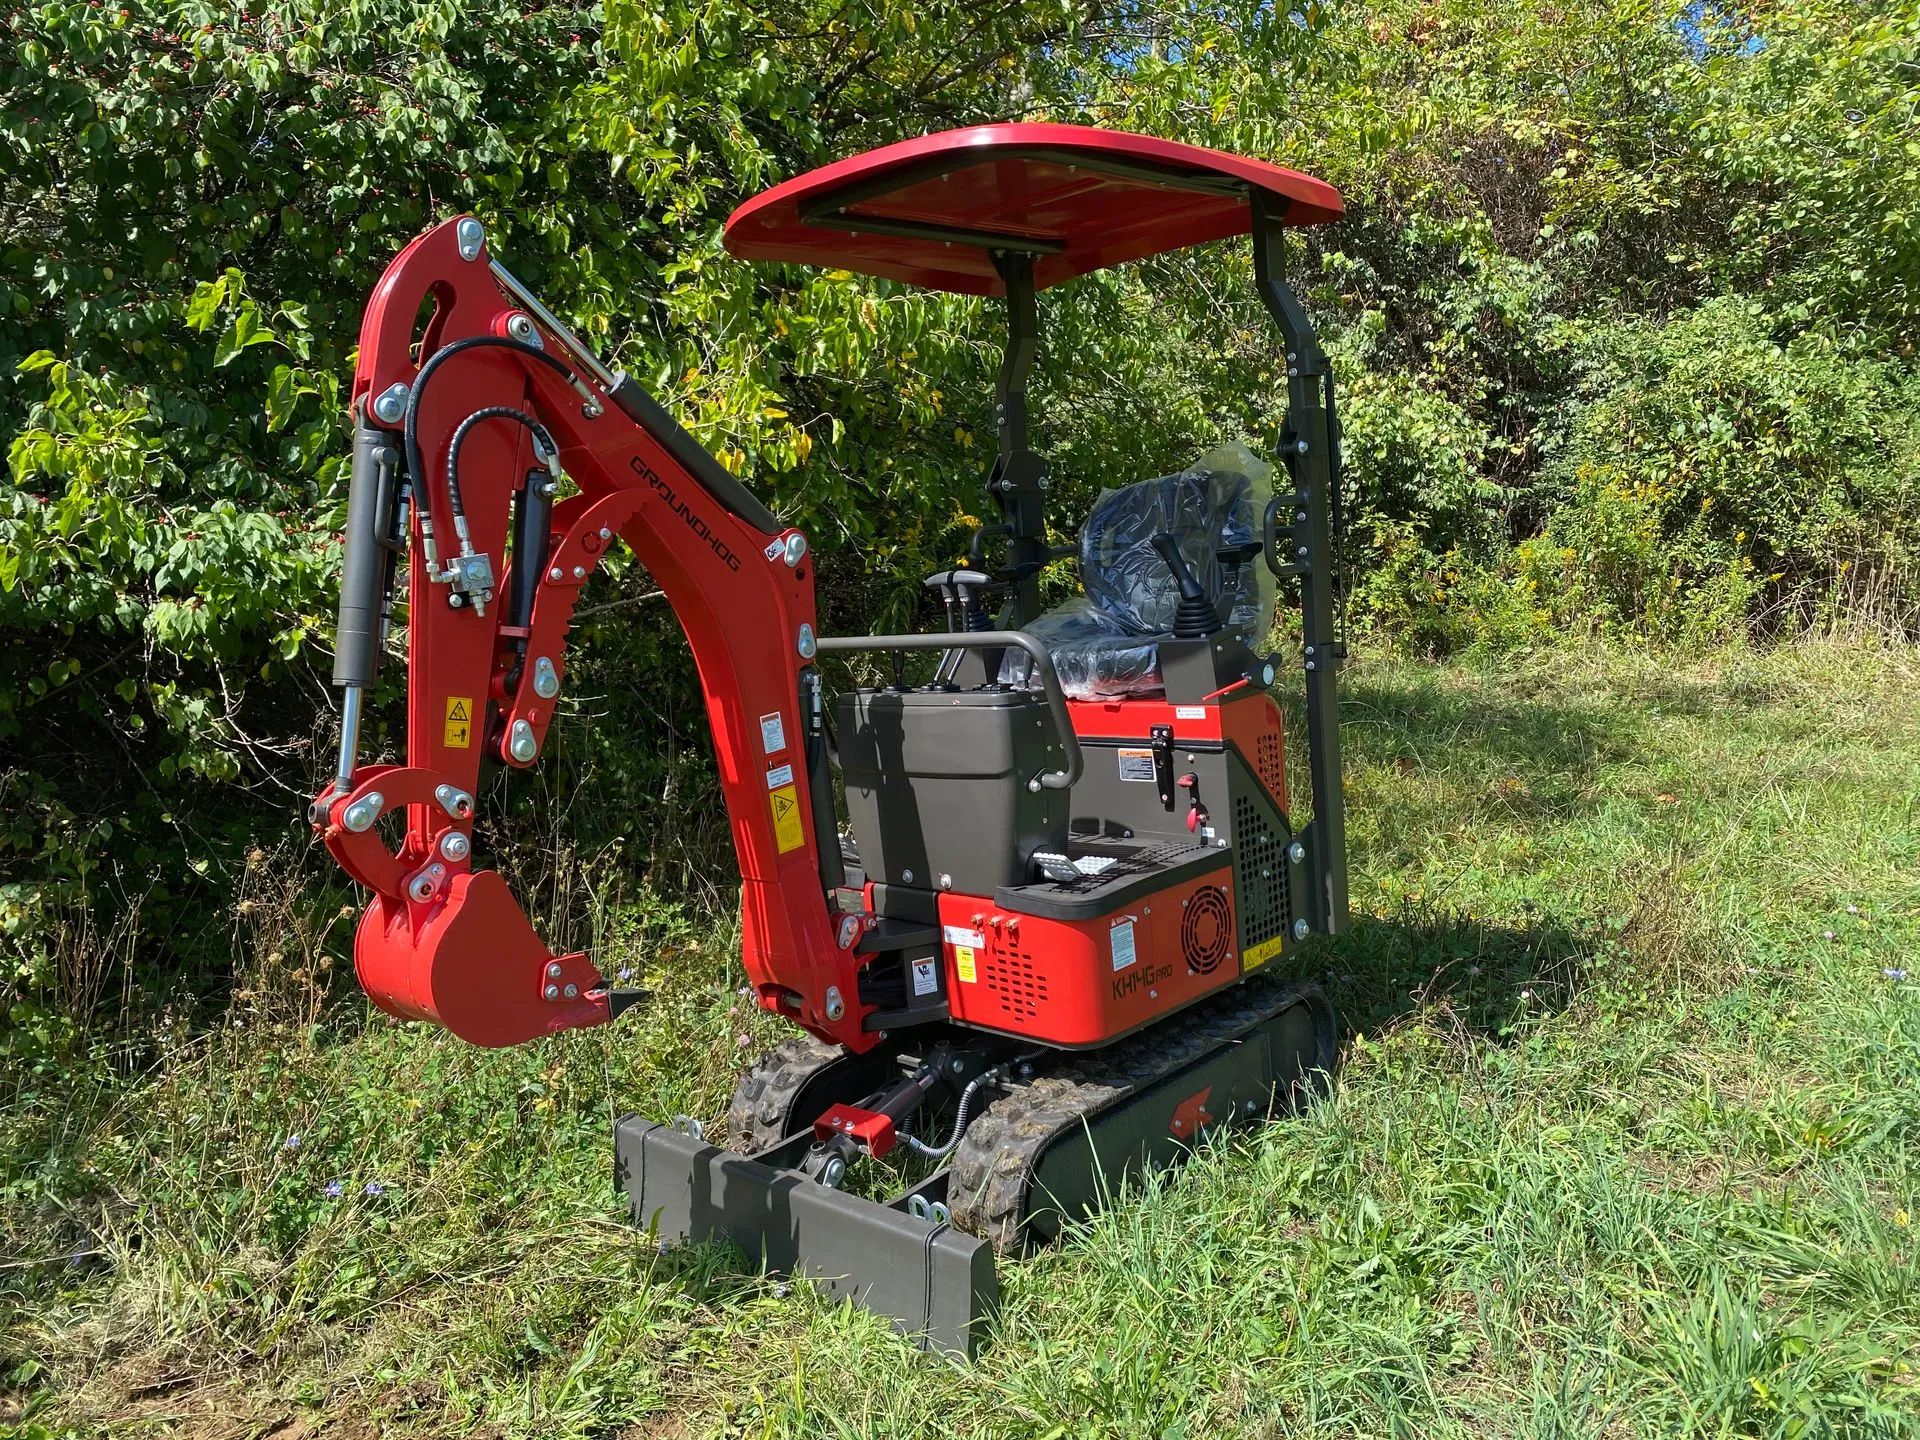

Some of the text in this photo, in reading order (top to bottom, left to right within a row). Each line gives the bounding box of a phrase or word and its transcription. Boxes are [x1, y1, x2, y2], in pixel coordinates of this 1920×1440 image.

[630, 456, 742, 572] GROUNDHOG
[1112, 964, 1173, 1000] KH14G PRO
